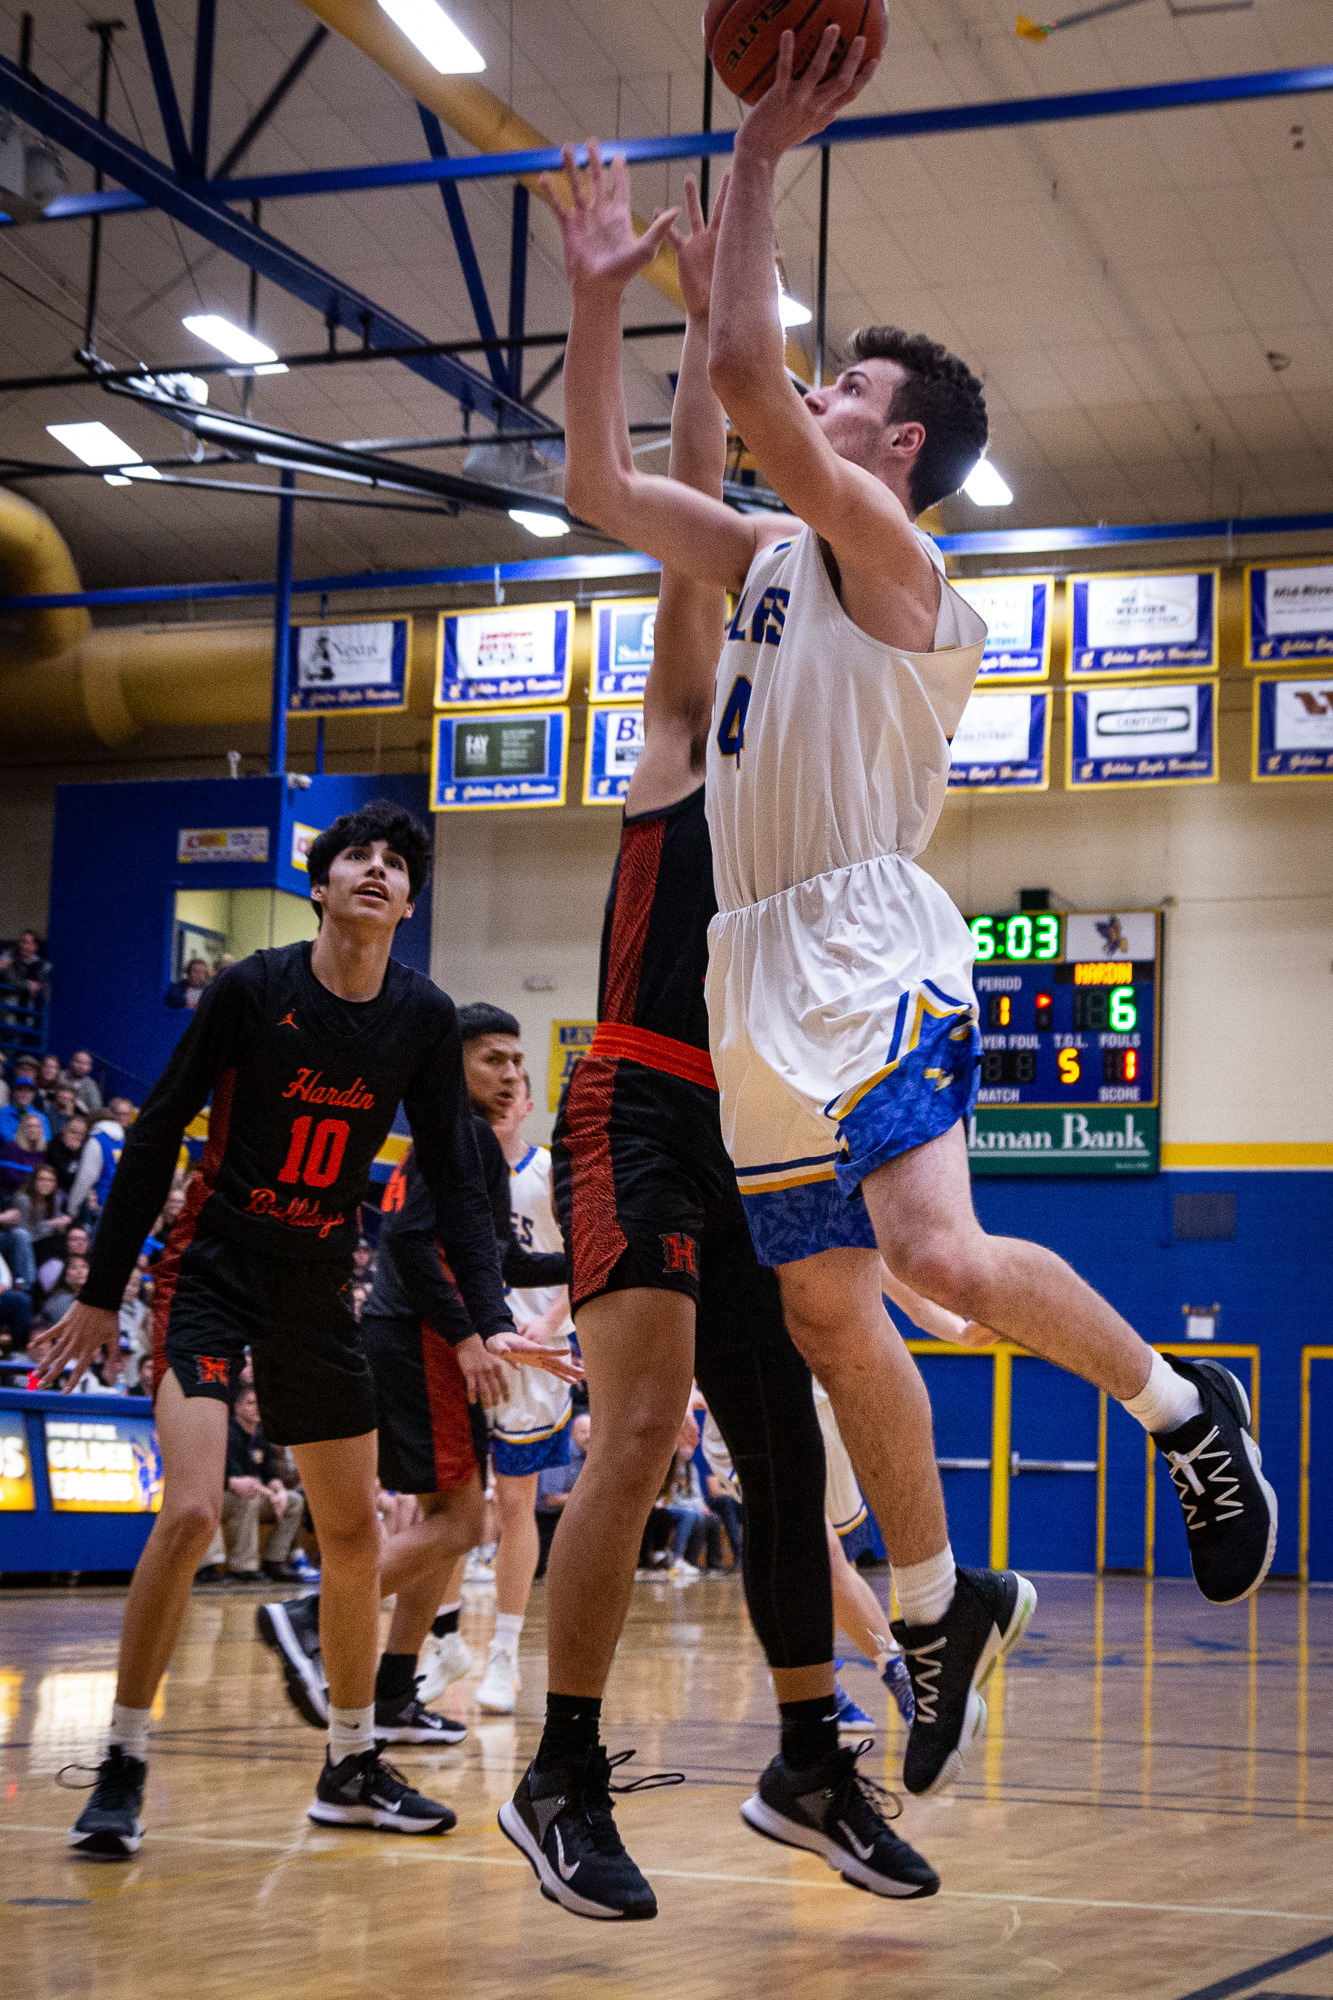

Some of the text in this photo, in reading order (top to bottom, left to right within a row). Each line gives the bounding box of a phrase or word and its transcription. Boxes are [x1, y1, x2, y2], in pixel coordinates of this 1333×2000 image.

[1274, 586, 1333, 598] Mid-Rive
[728, 585, 791, 648] LES
[1116, 715, 1170, 728] CENTURY
[970, 915, 1058, 961] 6:03
[977, 976, 1022, 990] PERIOD
[1074, 962, 1133, 985] HARDIN
[1110, 986, 1137, 1032] 6
[980, 1033, 1041, 1050] YER FOUL
[1098, 1033, 1142, 1048] FOULS
[1057, 1047, 1081, 1085] 5
[281, 1067, 375, 1110] Hardin
[977, 1088, 1021, 1102] MATCH
[1098, 1087, 1141, 1101] SCORE
[968, 1112, 1146, 1150] kman Bank
[277, 1115, 350, 1188] 10
[243, 1188, 345, 1238] Bulldogs
[659, 1232, 699, 1281] H
